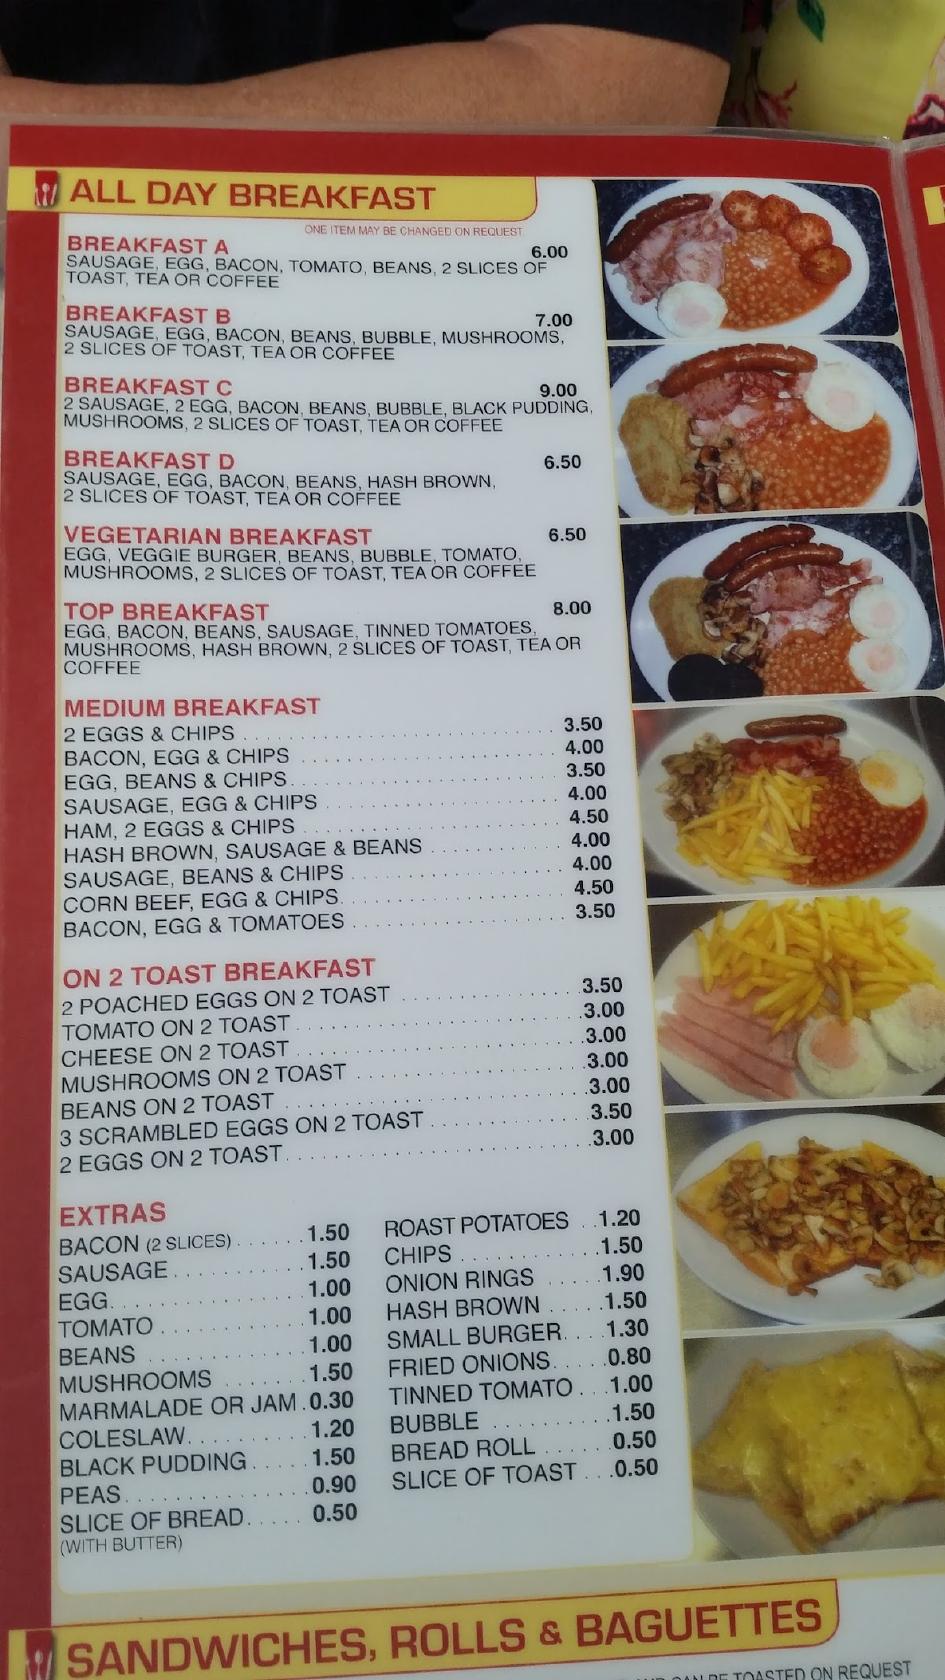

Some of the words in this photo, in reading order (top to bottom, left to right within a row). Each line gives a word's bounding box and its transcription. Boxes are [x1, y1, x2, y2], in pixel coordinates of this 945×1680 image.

[70, 179, 136, 204] ALL
[147, 181, 217, 206] DAY
[230, 184, 436, 210] BREAKFAST
[305, 225, 327, 234] ONE
[331, 225, 355, 235] ITEM
[359, 226, 380, 235] MAY
[383, 226, 396, 236] BE
[400, 226, 452, 236] CHANGED
[455, 227, 470, 236] ON
[473, 227, 523, 236] REQUEST
[68, 236, 207, 254] BREAKFAST
[214, 239, 228, 255] A
[532, 246, 568, 258] 6.00
[66, 255, 158, 270] SAUSAGE,
[166, 257, 209, 272] EGG,
[216, 258, 283, 273] BACON,
[289, 260, 366, 275] TOMATO,
[373, 261, 436, 275] BEANS,
[442, 262, 451, 274] 2
[457, 262, 518, 274] SLICES
[524, 262, 547, 274] OF
[66, 271, 128, 286] TOAST,
[135, 272, 169, 285] TEA
[174, 273, 200, 286] OR
[207, 274, 279, 288] COFFEE
[66, 305, 208, 324] BREAKFAST
[216, 309, 230, 324] B
[536, 313, 572, 327] 7.00
[65, 377, 209, 395] BREAKFAST
[217, 380, 232, 396] C
[540, 383, 577, 397] 9.00
[65, 450, 210, 470] BREAKFAST
[220, 454, 234, 470] D
[544, 455, 581, 469] 6.50
[64, 526, 221, 544] VEGETARIAN
[230, 528, 372, 546] BREAKFAST
[549, 528, 586, 542] 6.50
[65, 547, 110, 563] EGG,
[118, 548, 190, 562] VEGGIE
[198, 549, 280, 565] BURGER,
[288, 549, 354, 565] BEANS,
[361, 549, 436, 564] BUBBLE,
[442, 547, 521, 562] TOMATO,
[65, 565, 198, 582] MUSHROOMS,
[205, 567, 214, 580] 2
[221, 566, 286, 581] SLICES
[293, 567, 317, 581] OF
[323, 566, 385, 582] TOAST,
[391, 566, 427, 580] TEA
[431, 565, 457, 580] OR
[464, 564, 536, 579] COFFEE
[64, 603, 114, 621] TOP
[123, 603, 269, 621] BREAKFAST
[554, 601, 591, 615] 8.00
[65, 699, 164, 717] MEDIUM
[174, 698, 320, 716] BREAKFAST
[64, 728, 75, 742] 2
[84, 726, 143, 742] EGGS
[151, 726, 164, 742] &
[172, 725, 234, 741] CHIPS
[564, 716, 602, 732] 3.50
[65, 750, 145, 768] BACON,
[154, 749, 199, 765] EGG
[207, 749, 220, 765] &
[227, 747, 289, 764] CHIPS
[566, 739, 603, 755] 4.00
[65, 774, 116, 792] EGG,
[126, 773, 196, 789] BEANS
[204, 773, 216, 789] &
[224, 771, 286, 788] CHIPS
[567, 762, 605, 778] 3.50
[64, 797, 173, 815] SAUSAGE,
[183, 796, 227, 812] EGG
[235, 796, 247, 811] &
[254, 794, 317, 811] CHIPS
[568, 785, 606, 800] 4.00
[65, 823, 117, 839] HAM,
[125, 823, 136, 838] 2
[144, 820, 204, 837] EGGS
[212, 821, 224, 836] &
[231, 818, 294, 836] CHIPS
[570, 808, 608, 824] 4.50
[63, 969, 100, 989] ON
[109, 968, 122, 987] 2
[131, 964, 216, 985] TOAST
[225, 958, 375, 982] BREAKFAST
[62, 1001, 72, 1015] 2
[80, 995, 188, 1015] POACHED
[197, 991, 257, 1010] EGGS
[264, 990, 295, 1007] ON
[303, 989, 314, 1005] 2
[320, 986, 390, 1004] TOAST
[582, 977, 622, 993] 3.50
[62, 1021, 154, 1041] TOMATO
[162, 1019, 193, 1037] ON
[201, 1019, 212, 1035] 2
[219, 1015, 290, 1033] TOAST
[584, 1001, 624, 1019] 3.00
[62, 1047, 152, 1067] CHEESE
[161, 1044, 191, 1063] ON
[200, 1044, 210, 1060] 2
[217, 1040, 289, 1059] TOAST
[585, 1026, 626, 1044] 3.00
[60, 1201, 166, 1227] EXTRAS
[385, 1217, 456, 1238] ROAST
[461, 1211, 569, 1234] POTATOES
[599, 1209, 640, 1227] 1.20
[60, 1235, 138, 1256] BACON
[147, 1238, 161, 1255] (2
[166, 1234, 231, 1250] SLICES)
[308, 1223, 349, 1241] 1.50
[385, 1244, 451, 1266] CHIPS
[600, 1236, 642, 1255] 1.50
[58, 1260, 167, 1284] SAUSAGE
[308, 1251, 350, 1270] 1.50
[386, 1272, 457, 1293] ONION
[466, 1268, 534, 1289] RINGS
[602, 1263, 644, 1282] 1.90
[59, 1291, 107, 1311] EGG
[309, 1278, 350, 1297] 1.00
[387, 1300, 447, 1321] HASH
[456, 1296, 539, 1317] BROWN
[605, 1291, 646, 1310] 1.50
[58, 1317, 153, 1338] TOMATO
[309, 1306, 351, 1325] 1.00
[388, 1328, 461, 1349] SMALL
[468, 1322, 561, 1345] BURGER
[606, 1318, 648, 1337] 1.30
[60, 1345, 135, 1366] BEANS
[310, 1334, 351, 1353] 1.00
[389, 1356, 454, 1378] FRIED
[462, 1351, 550, 1374] ONIONS
[608, 1346, 651, 1366] 0.80
[60, 1370, 211, 1394] MUSHROOMS
[310, 1362, 352, 1382] 1.50
[389, 1384, 472, 1405] TINNED
[479, 1378, 572, 1400] TOMATO
[610, 1374, 653, 1394] 1.00
[61, 1485, 120, 1505] PEAS
[313, 1475, 356, 1494] 0.90
[61, 1538, 106, 1557] (WITH
[113, 1535, 182, 1552] BUTTER)
[68, 1628, 376, 1678] SANDWICHES,
[391, 1618, 525, 1659] ROLLS
[540, 1621, 562, 1645] &
[576, 1598, 821, 1647] BAGUETTES
[811, 1666, 833, 1680] ON
[838, 1660, 911, 1680] REQUEST
